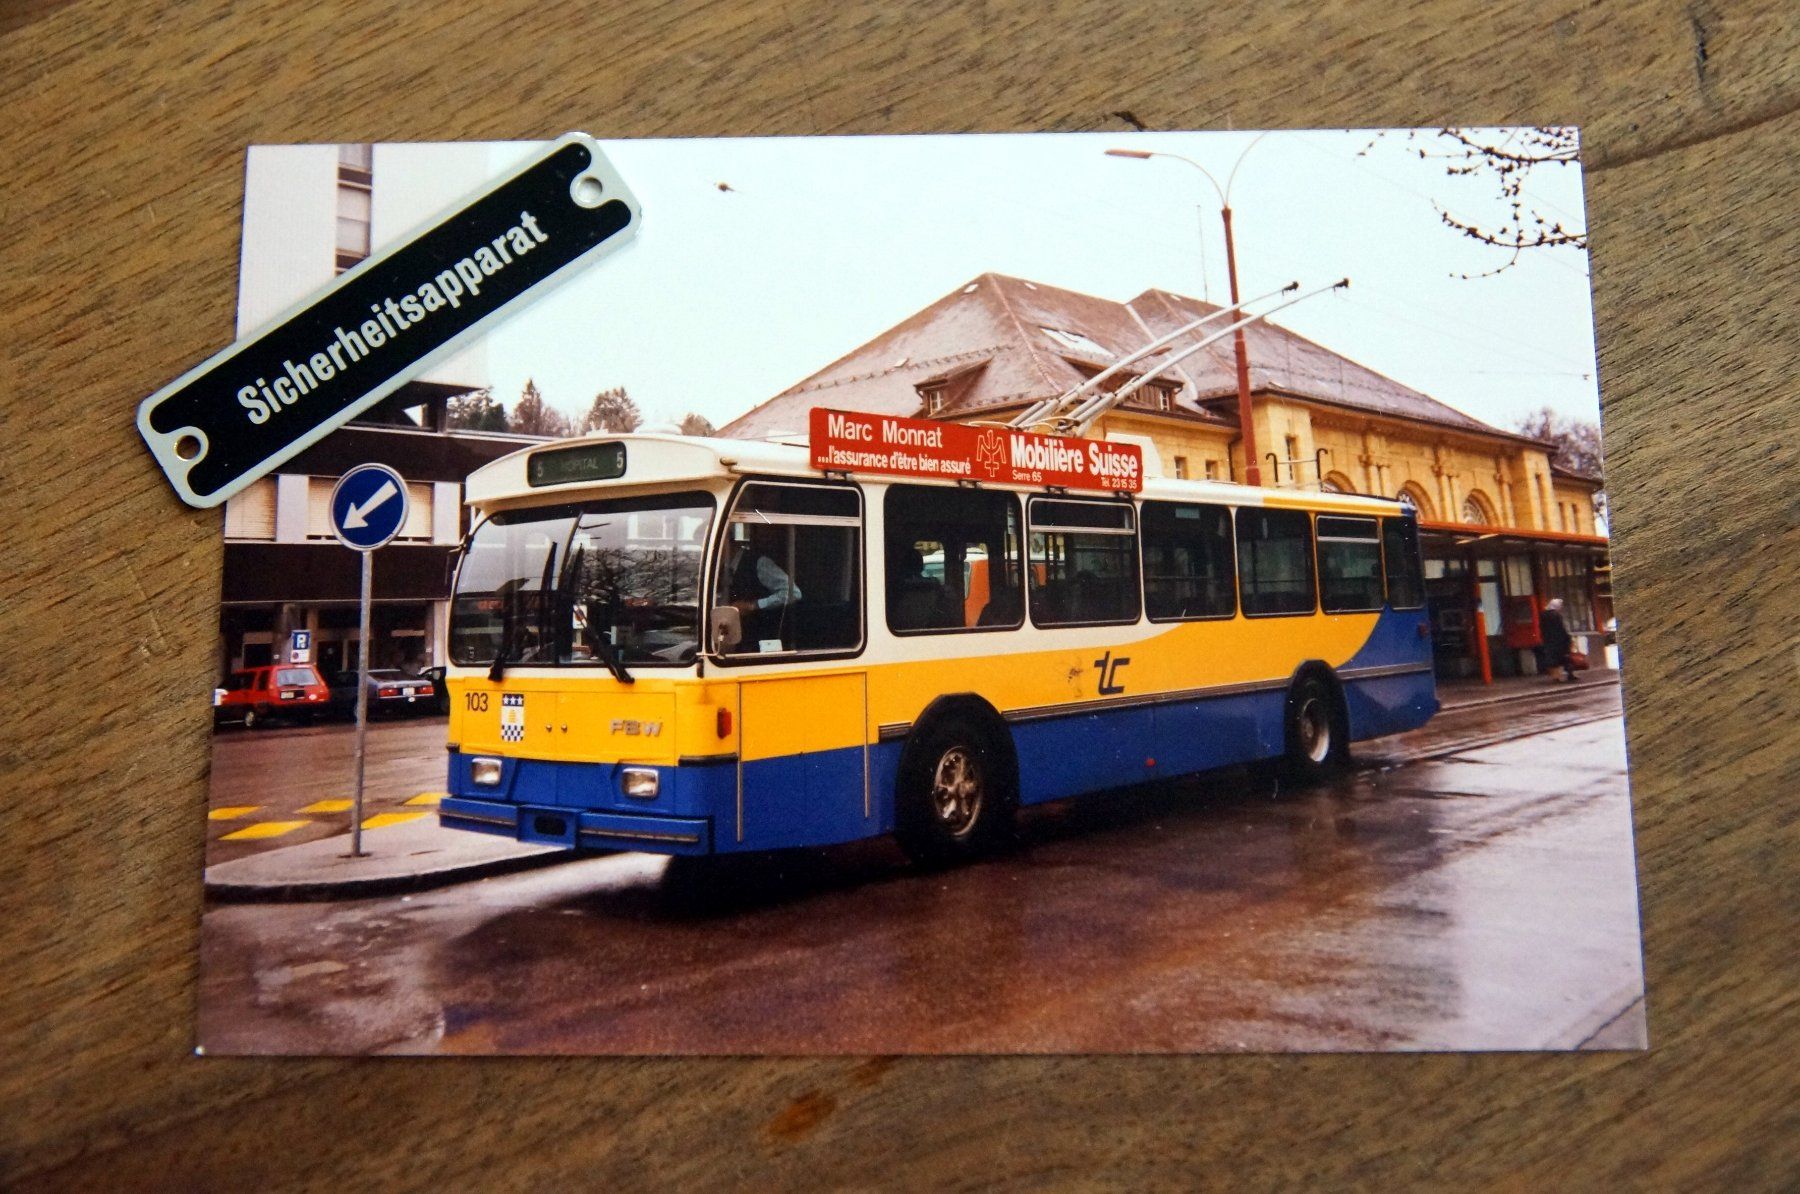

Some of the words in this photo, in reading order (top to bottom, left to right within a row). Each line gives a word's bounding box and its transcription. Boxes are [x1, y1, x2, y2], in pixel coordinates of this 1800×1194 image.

[237, 210, 548, 425] Sicherheitsapparat
[828, 413, 873, 441] Marc
[882, 419, 943, 448] Monnat
[616, 451, 624, 469] 5
[889, 451, 917, 470] d'être
[918, 453, 939, 472] bien
[940, 457, 971, 475] assuré
[1010, 434, 1084, 473] Mobilière
[1088, 442, 1138, 478] Suisse
[1012, 469, 1031, 481] Serre
[1031, 471, 1042, 482] 65
[1112, 478, 1121, 488] 23
[1128, 480, 1137, 489] 35
[465, 692, 488, 712] 103
[610, 719, 663, 737] FBW
